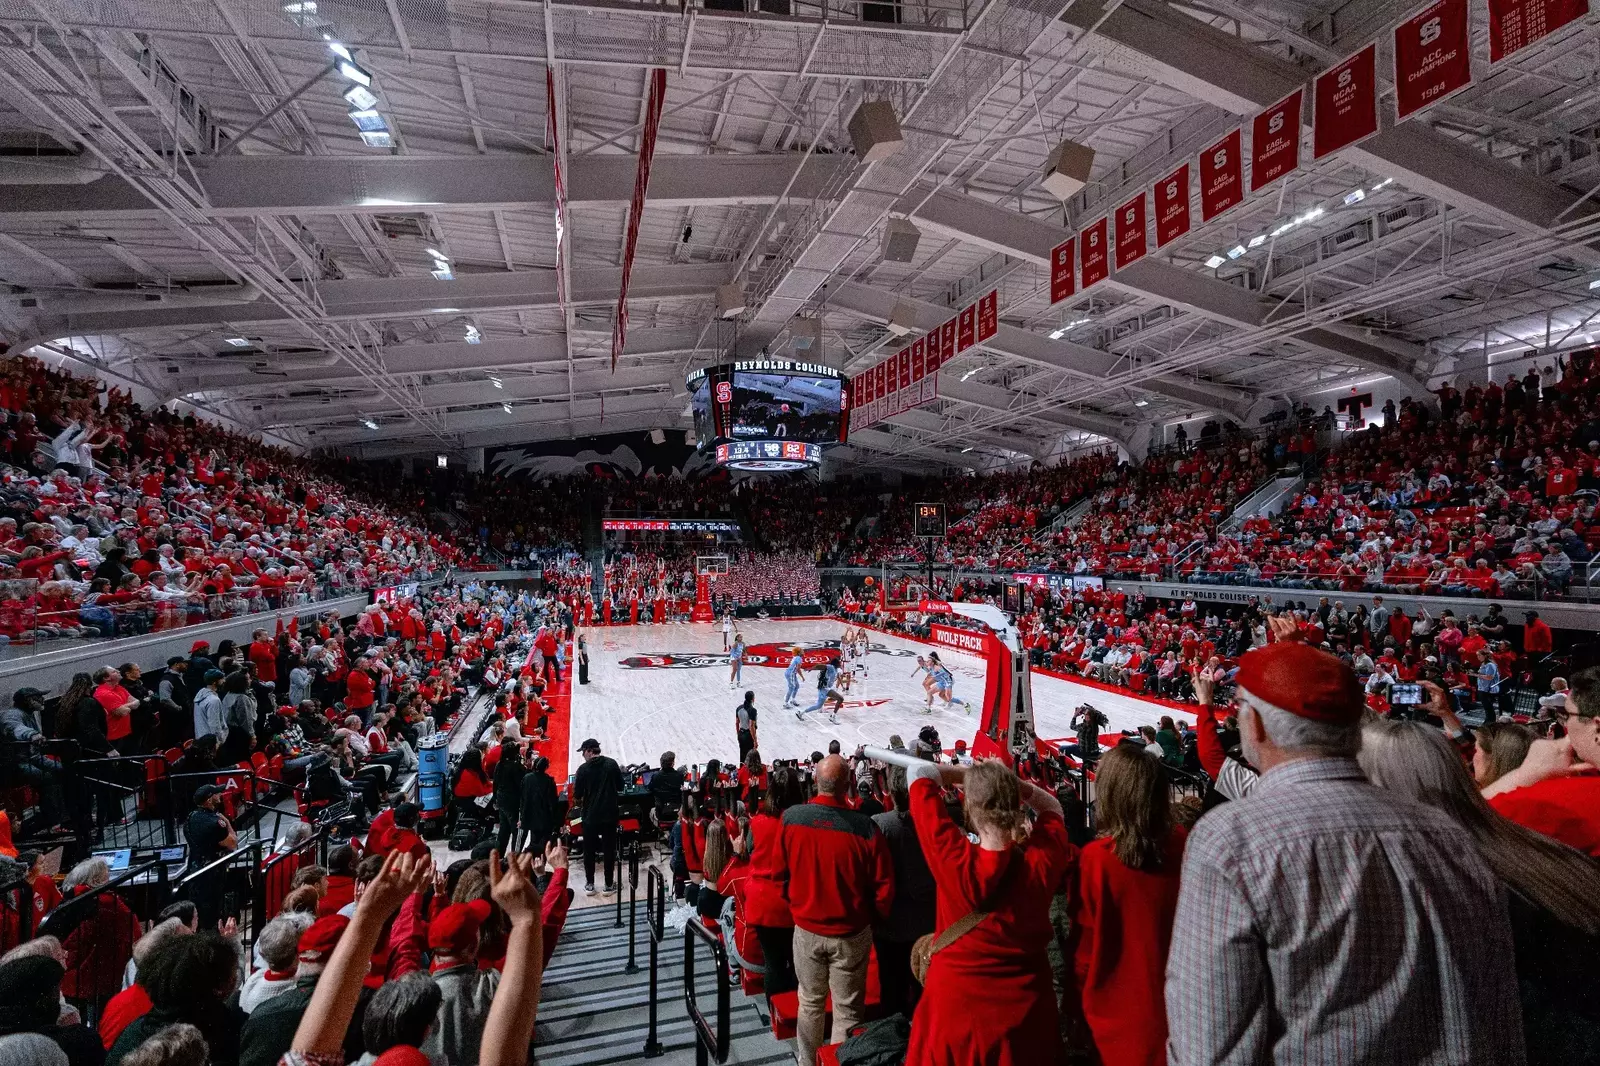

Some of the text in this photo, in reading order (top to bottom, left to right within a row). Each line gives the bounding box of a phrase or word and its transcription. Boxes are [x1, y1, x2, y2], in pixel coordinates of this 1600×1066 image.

[1502, 7, 1520, 22] 2007
[1502, 15, 1521, 29] 2008
[1526, 8, 1546, 23] 2015
[1502, 22, 1522, 36] 2009
[1502, 29, 1522, 43] 2010
[1502, 36, 1521, 50] 2011
[1421, 48, 1442, 67] ACC
[1408, 49, 1457, 82] CHAMPIONS
[1333, 83, 1357, 102] NCAA
[1421, 81, 1446, 100] 1984
[1336, 93, 1354, 107] FINALS
[1258, 139, 1291, 162] CHAMPIONS
[1266, 137, 1283, 151] EAGL
[1265, 164, 1282, 178] 1999
[1208, 175, 1236, 196] CHAMPIONS
[734, 361, 839, 378] REYNOLDS COLISEUM
[1338, 393, 1373, 428] T
[1170, 589, 1260, 602] AT RENOLDS COLISE
[225, 777, 239, 790] A
